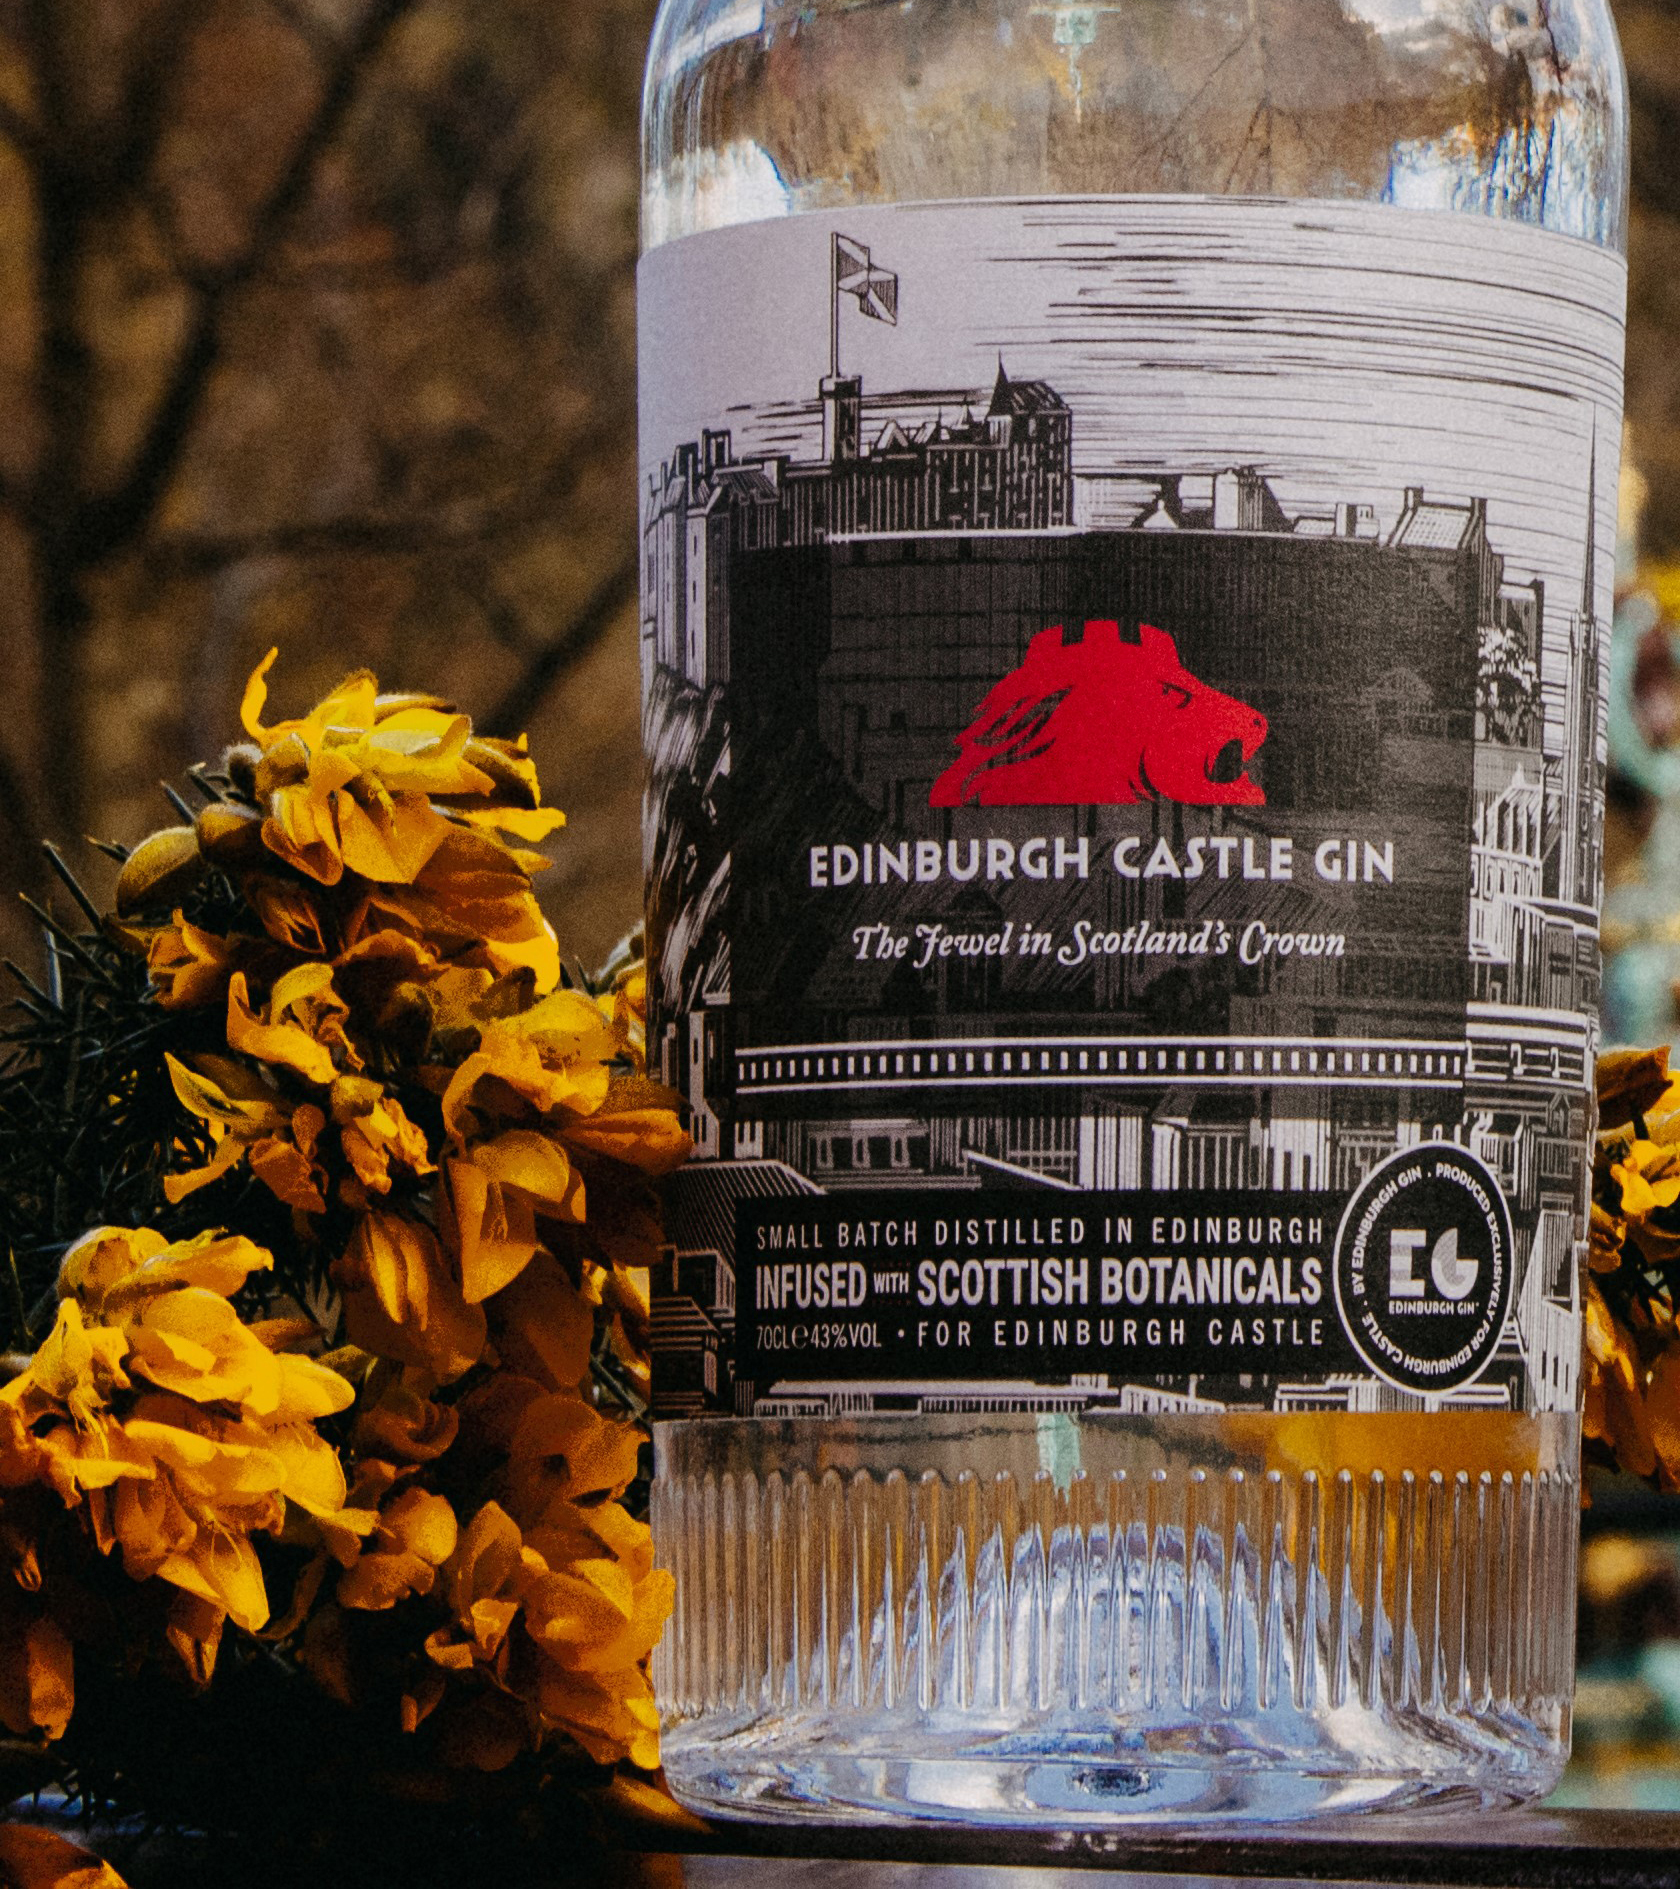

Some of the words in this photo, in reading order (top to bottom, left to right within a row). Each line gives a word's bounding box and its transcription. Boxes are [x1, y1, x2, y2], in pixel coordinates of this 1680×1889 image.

[809, 836, 1090, 888] EDINBURGH
[1113, 835, 1294, 881] CASTLE
[1314, 838, 1395, 884] GIN
[852, 922, 910, 961] The
[912, 920, 1014, 970] Jewel
[1018, 922, 1053, 956] in
[1057, 919, 1232, 967] Scotland's
[1238, 919, 1346, 966] Crown
[1397, 1164, 1423, 1188] GIN
[1435, 1162, 1491, 1212] PRODUCED
[756, 1223, 824, 1251] SMALL
[837, 1219, 918, 1248] BATCH
[934, 1217, 1086, 1246] DISTILLED
[1105, 1217, 1132, 1245] IN
[1152, 1216, 1323, 1245] EDINBURGH
[1351, 1179, 1400, 1271] EDINBURGH
[756, 1261, 868, 1310] INFUSED
[873, 1271, 910, 1294] WITH
[916, 1257, 1089, 1306] SCOTTISH
[1100, 1256, 1323, 1305] BOTANICALS
[1352, 1272, 1366, 1296] BY
[1485, 1211, 1503, 1323] EXCLUSIVELY
[1388, 1300, 1455, 1315] EDINBURGH
[918, 1320, 971, 1348] FOR
[994, 1318, 1185, 1347] EDINBURGH
[1208, 1318, 1324, 1346] CASTLE
[1361, 1312, 1404, 1365] CASTLE
[1470, 1318, 1491, 1352] FOR
[1403, 1349, 1473, 1376] EDINBURGH
